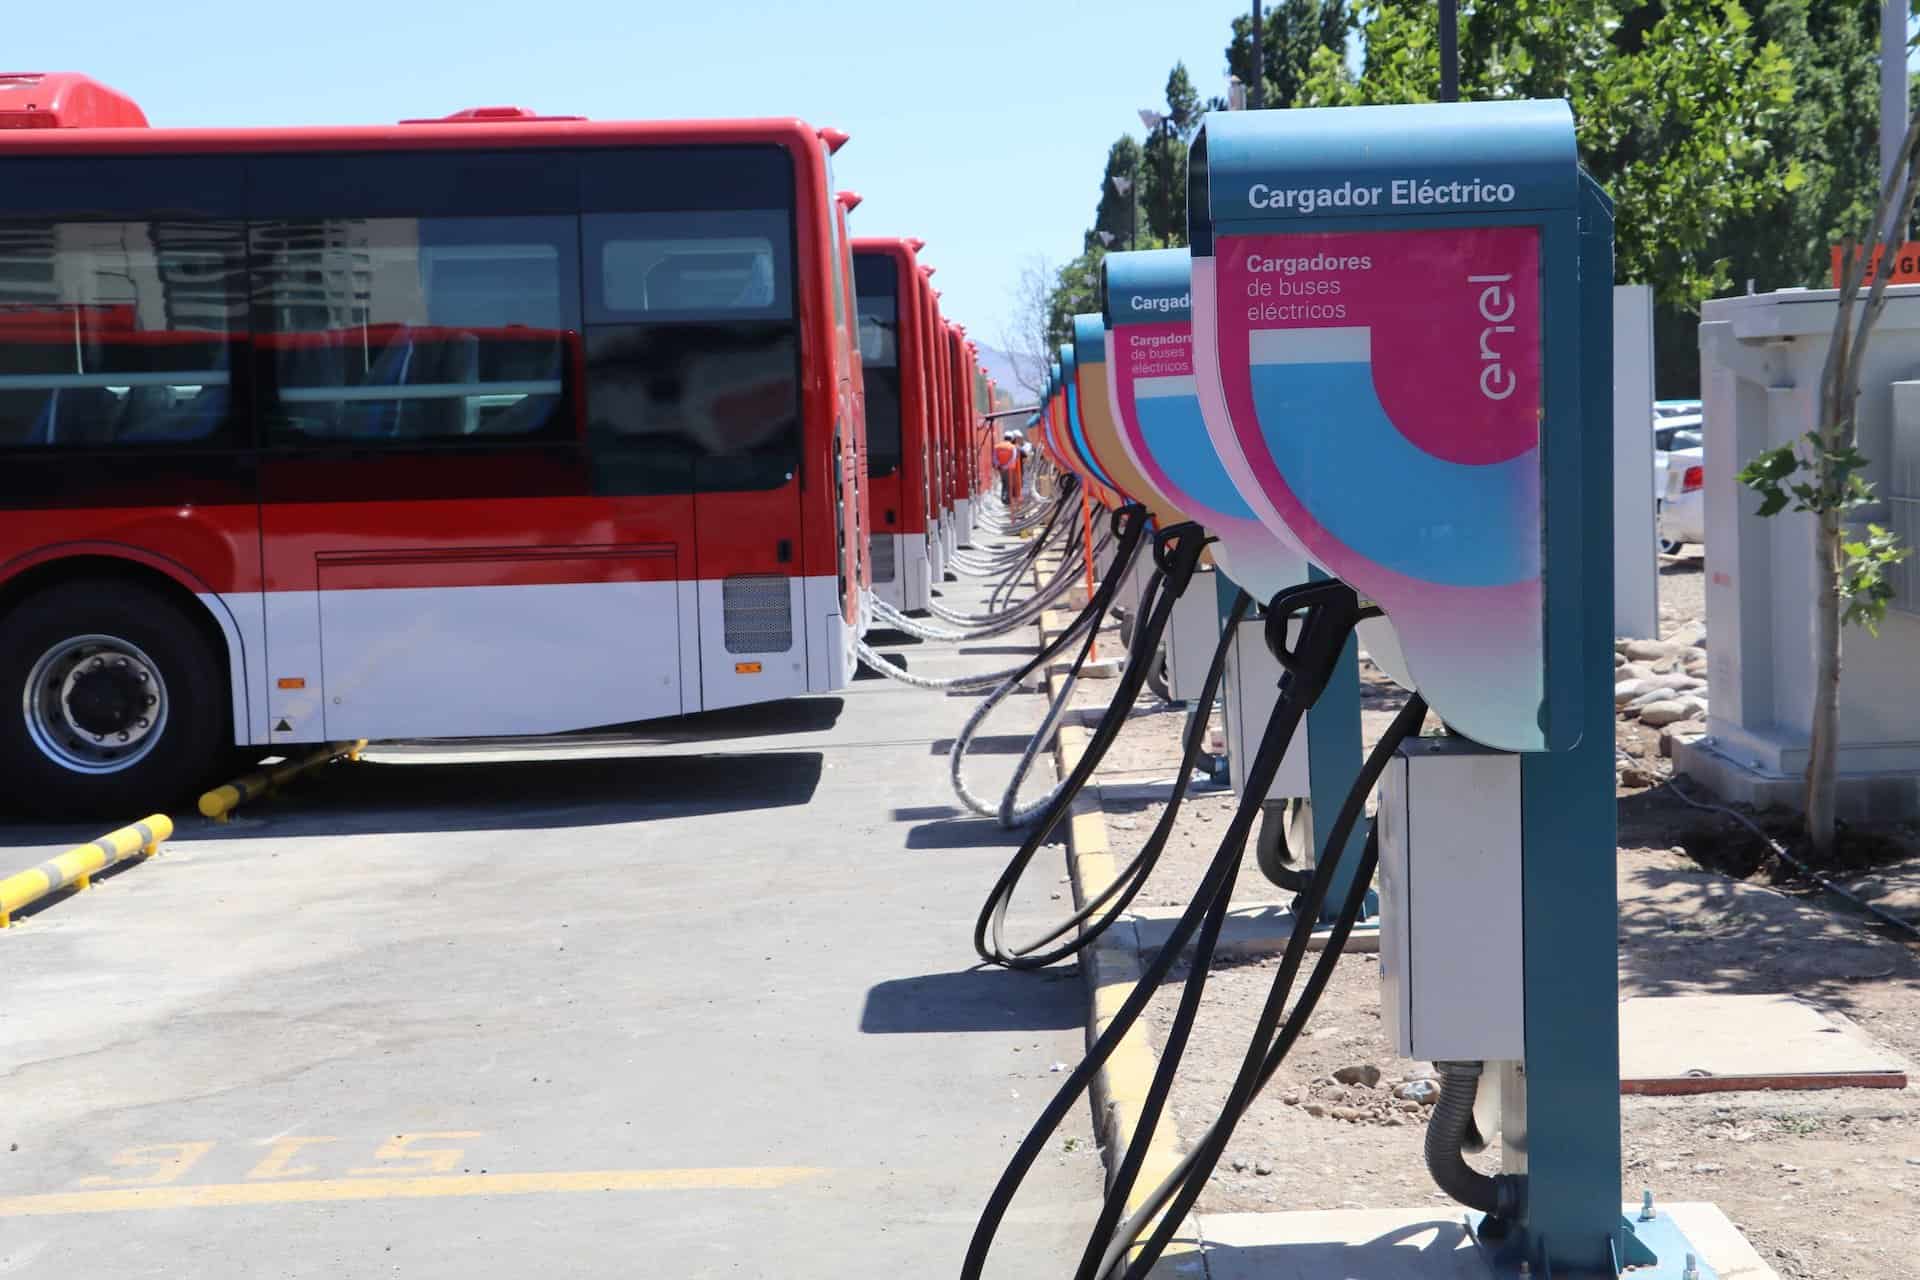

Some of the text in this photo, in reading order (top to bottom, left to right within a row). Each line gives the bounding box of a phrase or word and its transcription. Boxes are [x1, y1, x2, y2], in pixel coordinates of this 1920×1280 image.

[1248, 178, 1515, 213] Cargador Eléctrico
[1247, 253, 1372, 275] Cargadores
[1247, 278, 1341, 297] de buses
[1131, 293, 1191, 312] Cargad
[1247, 301, 1346, 321] eléctricos
[1467, 273, 1516, 400] enel
[1130, 347, 1185, 360] de buses
